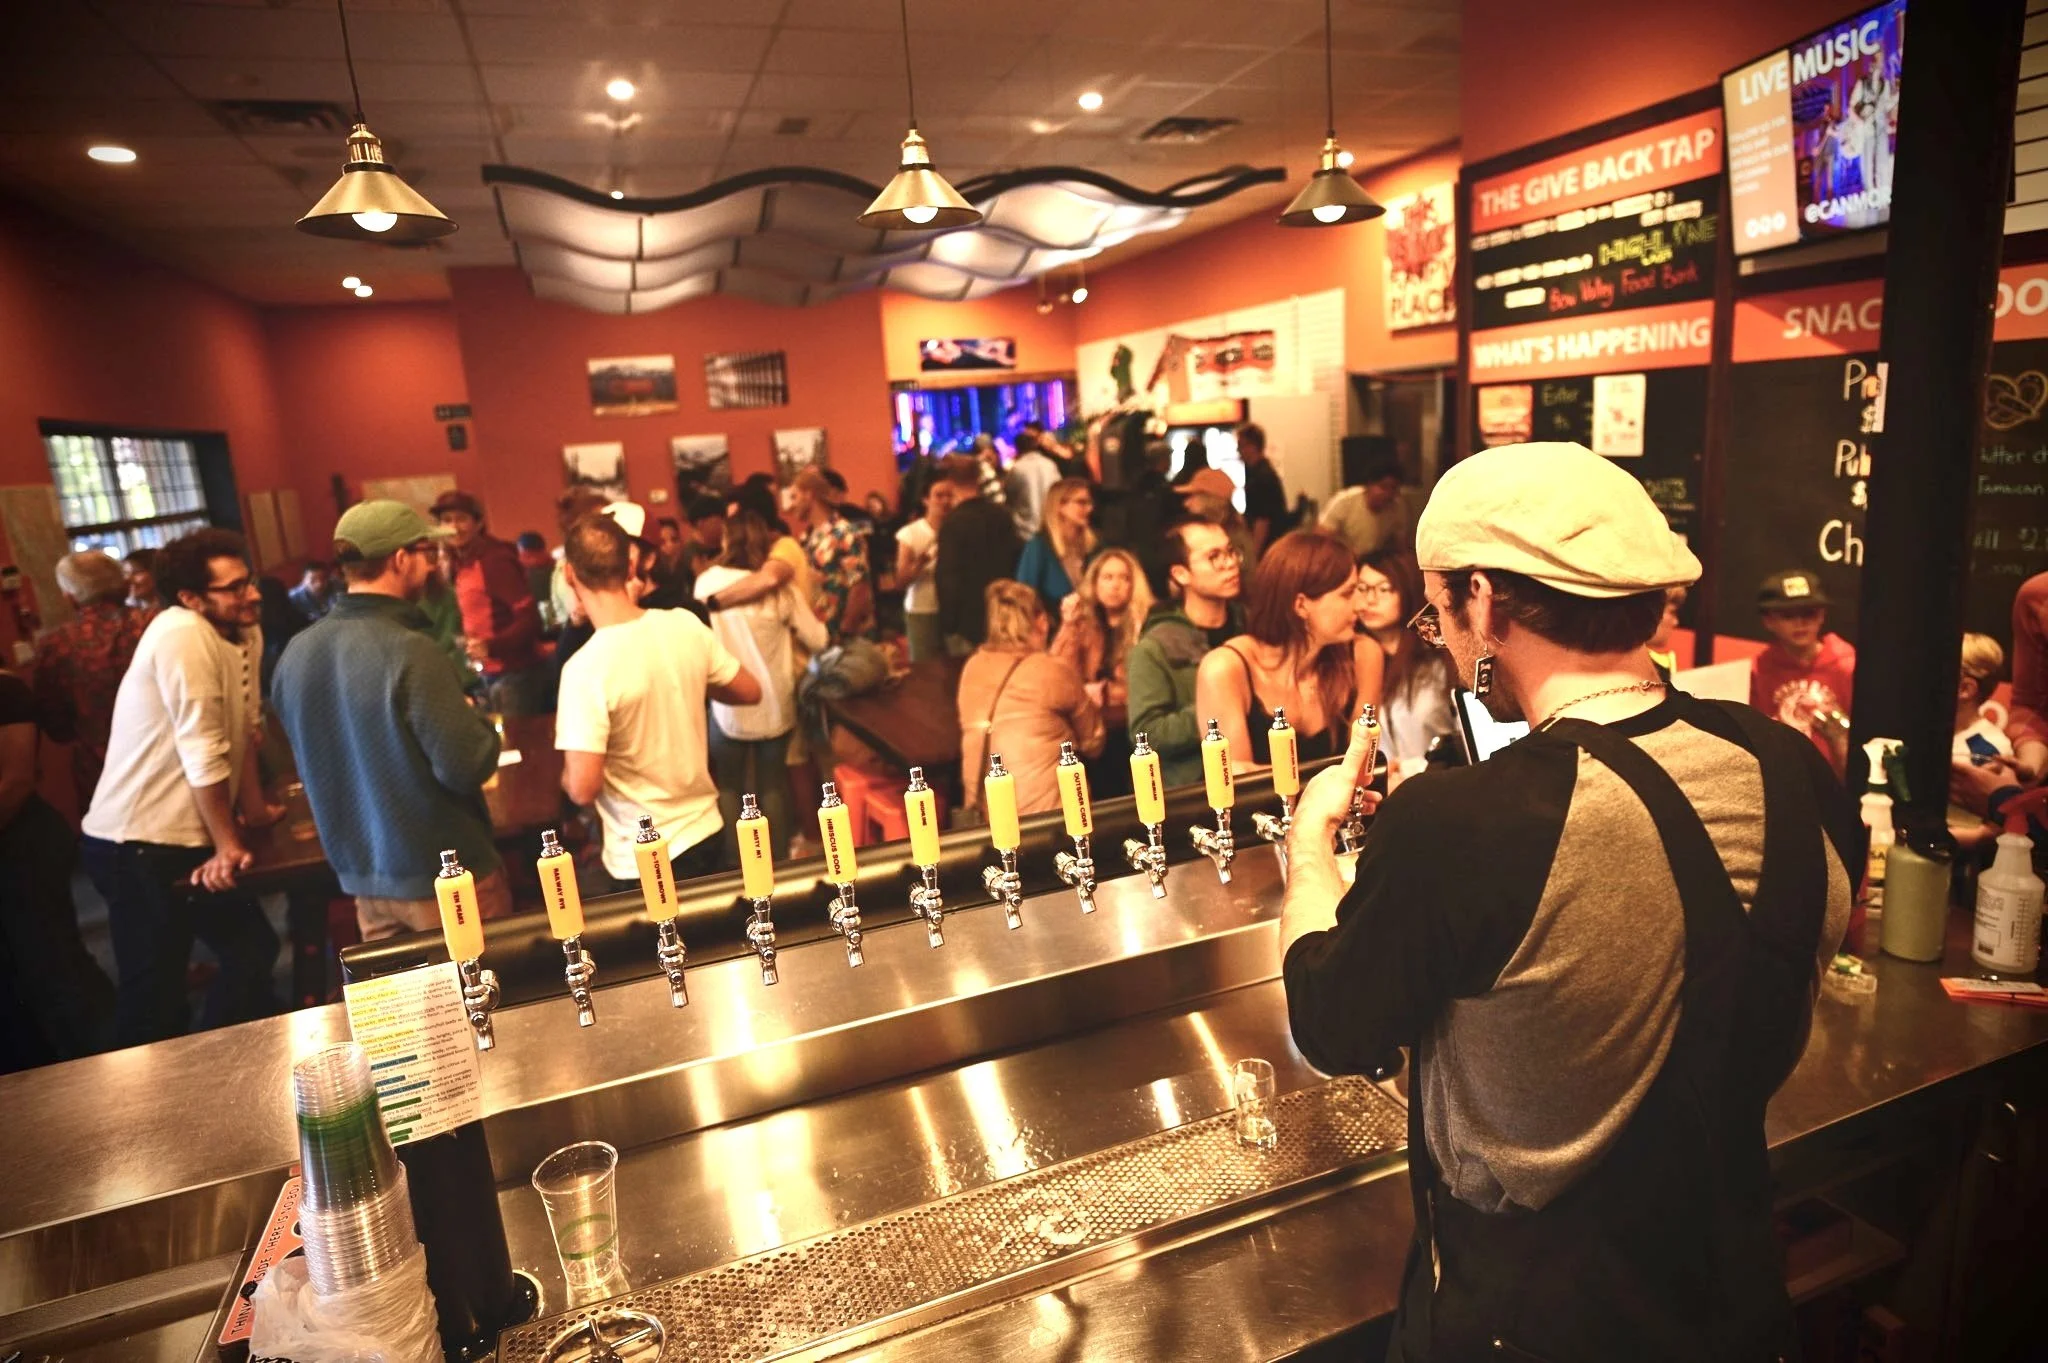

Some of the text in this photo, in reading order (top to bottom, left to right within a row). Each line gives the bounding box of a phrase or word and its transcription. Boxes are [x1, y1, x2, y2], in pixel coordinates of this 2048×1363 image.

[1739, 20, 1881, 106] LIVE MUSIC
[1479, 183, 1521, 217] THE
[1524, 166, 1580, 205] GIVE
[1584, 143, 1655, 191] BACK
[1658, 127, 1715, 170] TAP
[1783, 297, 1883, 340] SNAC
[1473, 317, 1713, 368] WHAT'S HAPPENING
[1818, 519, 1864, 567] Ch
[1074, 772, 1089, 829] OUTSIDER CIDER
[753, 828, 761, 850] MISTY
[826, 818, 842, 876] HIBISCUS SODA
[452, 890, 465, 926] TEN PEAKS
[553, 867, 566, 910] RAILWAY RYE
[657, 883, 668, 905] BROWN
[278, 1213, 289, 1225] IS
[281, 1199, 294, 1216] NO
[265, 1224, 285, 1254] THERE
[230, 1302, 252, 1336] THINK
